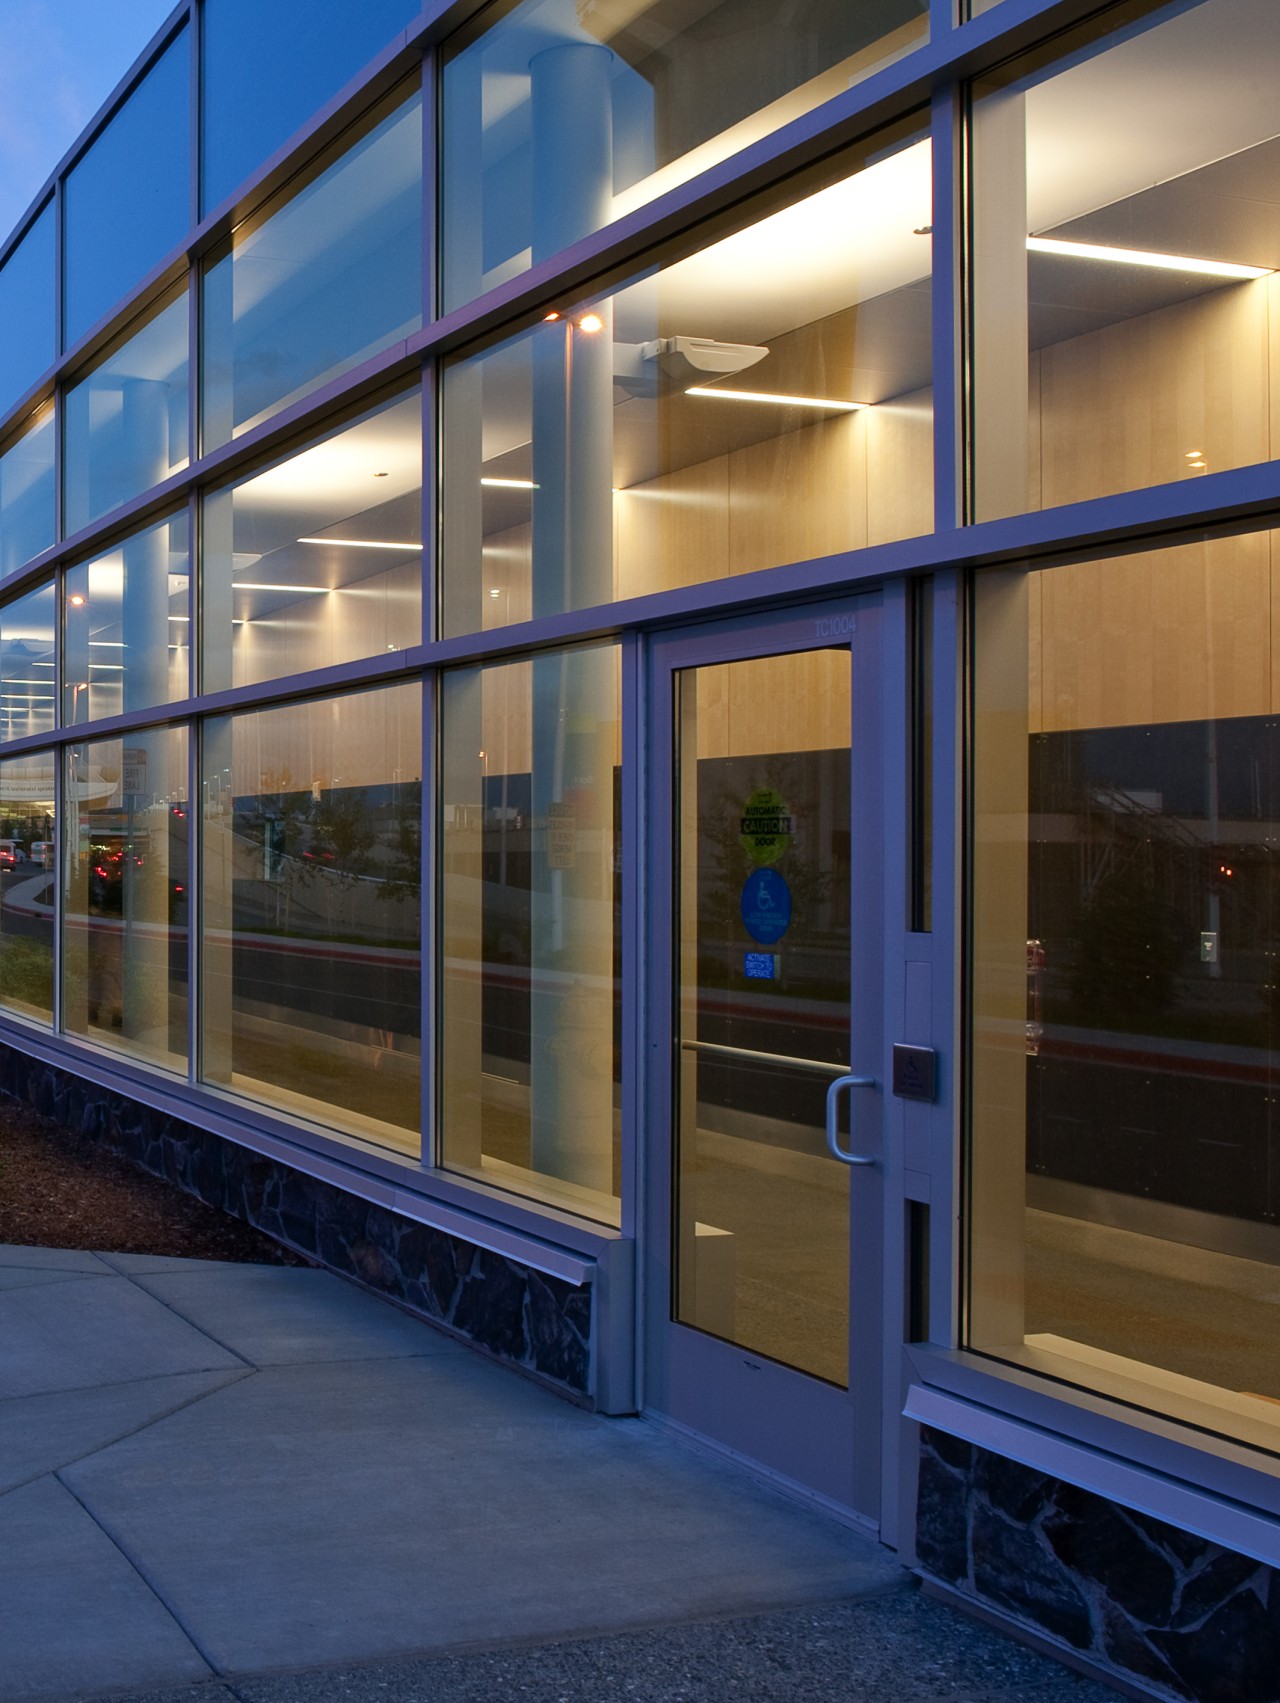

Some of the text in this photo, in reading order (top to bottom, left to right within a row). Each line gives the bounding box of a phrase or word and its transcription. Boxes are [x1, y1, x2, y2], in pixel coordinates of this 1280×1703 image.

[814, 614, 856, 637] TC1004
[745, 806, 786, 816] AUTOMATIC
[743, 819, 788, 833] CAUTION
[754, 837, 776, 846] DOOR
[747, 953, 770, 962] ACTIVATE
